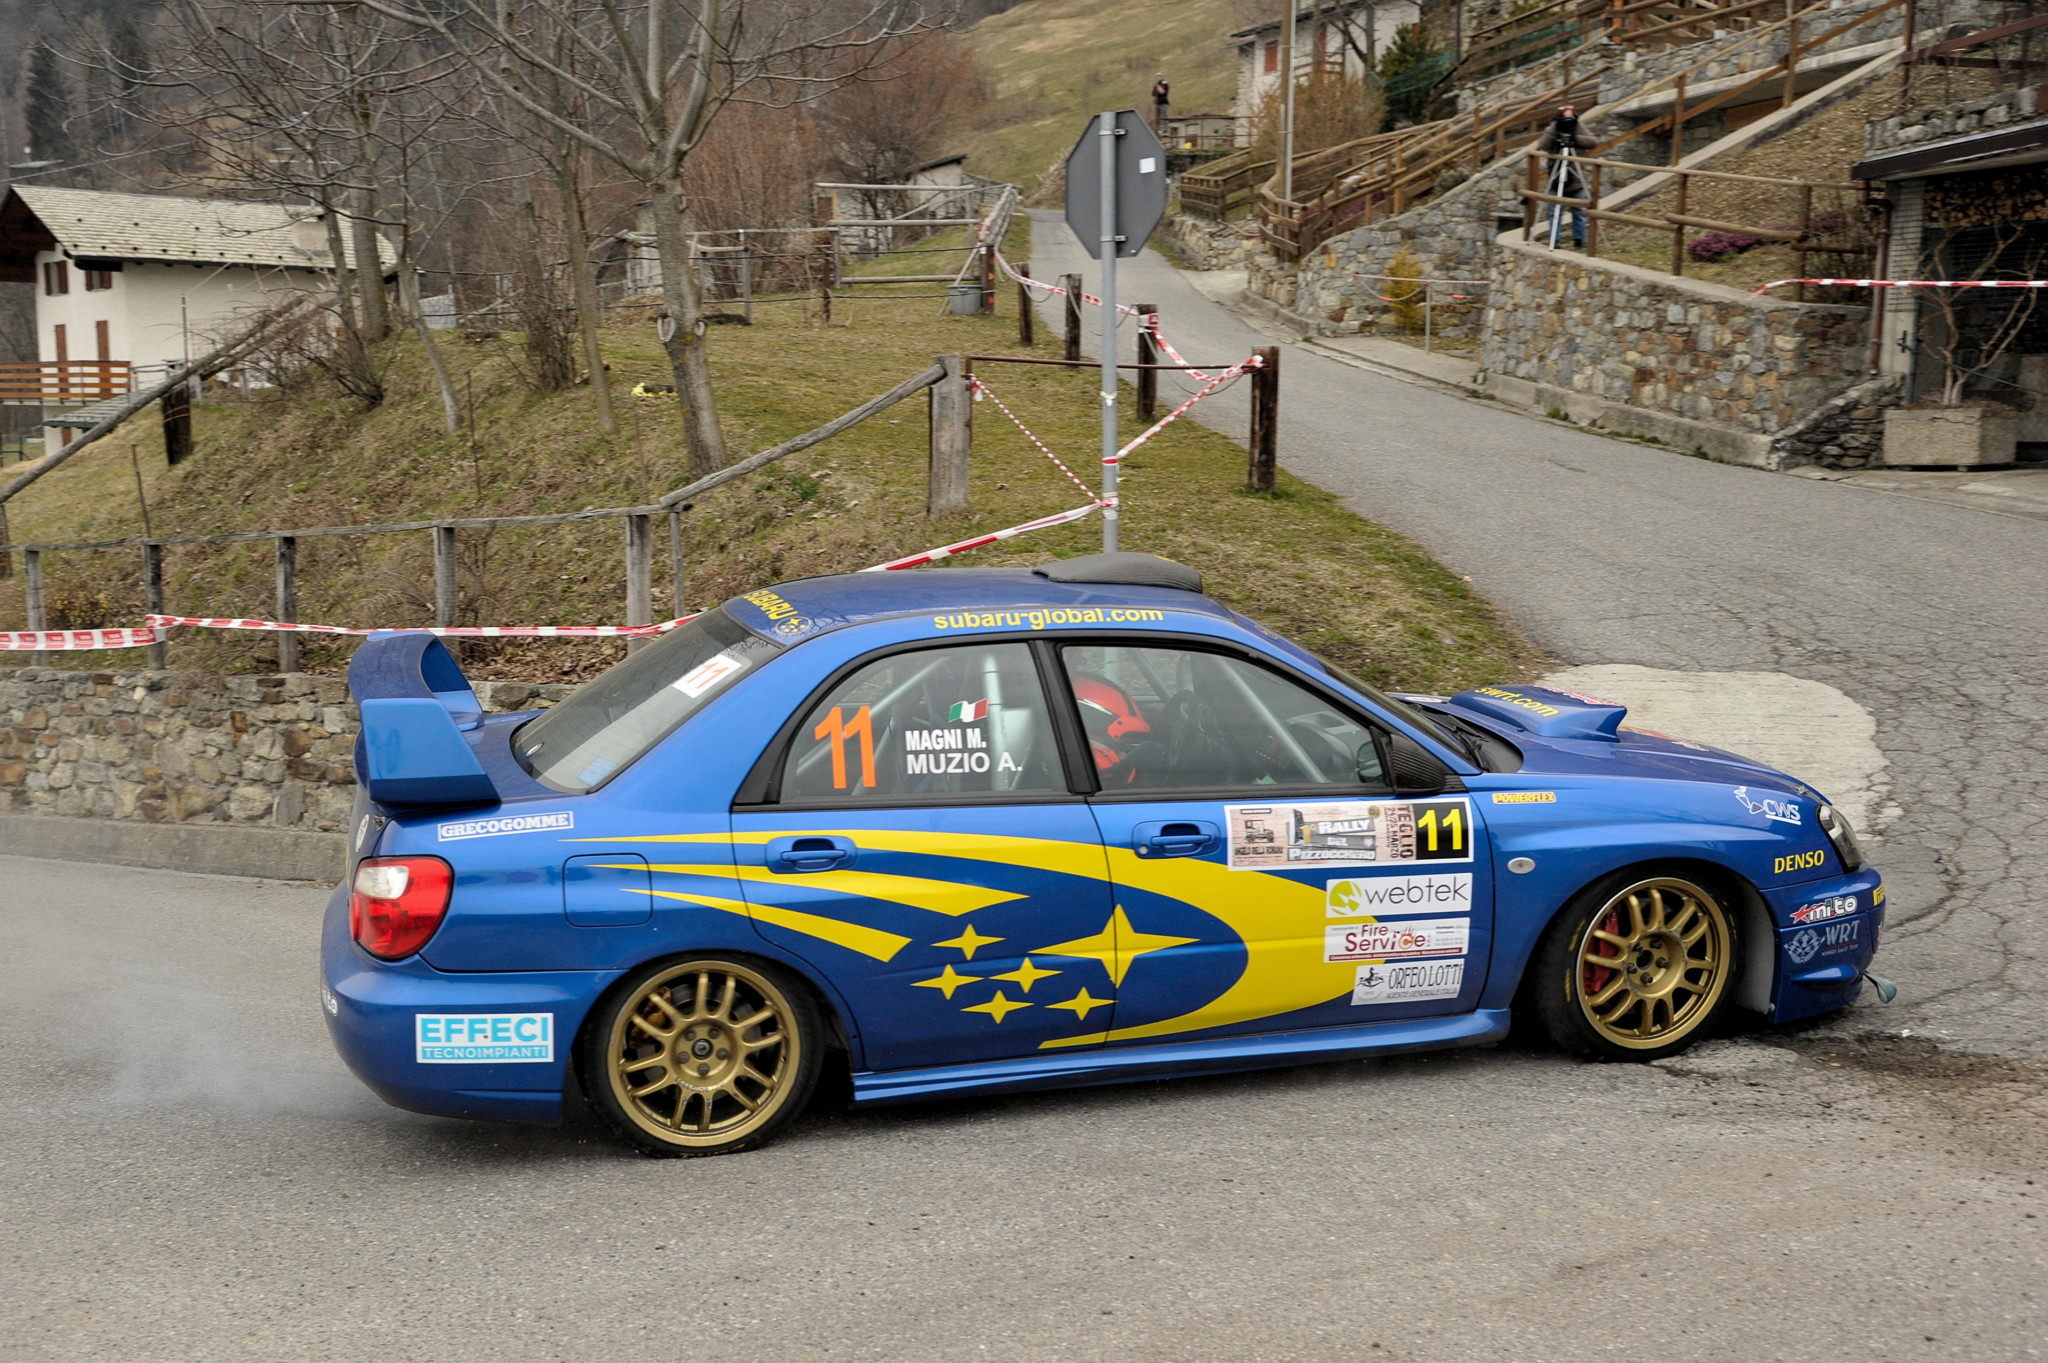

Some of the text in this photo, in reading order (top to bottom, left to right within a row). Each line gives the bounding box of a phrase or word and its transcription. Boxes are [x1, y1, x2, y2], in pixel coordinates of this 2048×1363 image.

[743, 590, 798, 620] SUBARU
[933, 608, 1164, 630] subaru-global.com
[685, 660, 729, 690] 11
[1475, 687, 1560, 717] swrt.com
[814, 705, 876, 789] 11
[905, 728, 987, 751] MAGNI M.
[906, 751, 1023, 774] MUZIO A.
[1494, 792, 1556, 803] POWERFLEX
[1764, 799, 1801, 821] CWS
[441, 814, 569, 837] GRECOGOMME
[1318, 819, 1370, 835] RALLY
[1397, 804, 1414, 859] TEGLIO
[1417, 808, 1463, 851] 11
[1289, 848, 1376, 860] PIZZOCCHERO
[1774, 850, 1825, 874] DENSO
[1364, 876, 1469, 905] webtek
[1345, 932, 1426, 952] Service
[1361, 924, 1389, 937] Fire
[1826, 920, 1860, 945] WRT
[1388, 963, 1462, 989] ORFEO LOTTI
[420, 1016, 549, 1043] EFFECI
[424, 1046, 547, 1059] TECNOIMPIANTI
